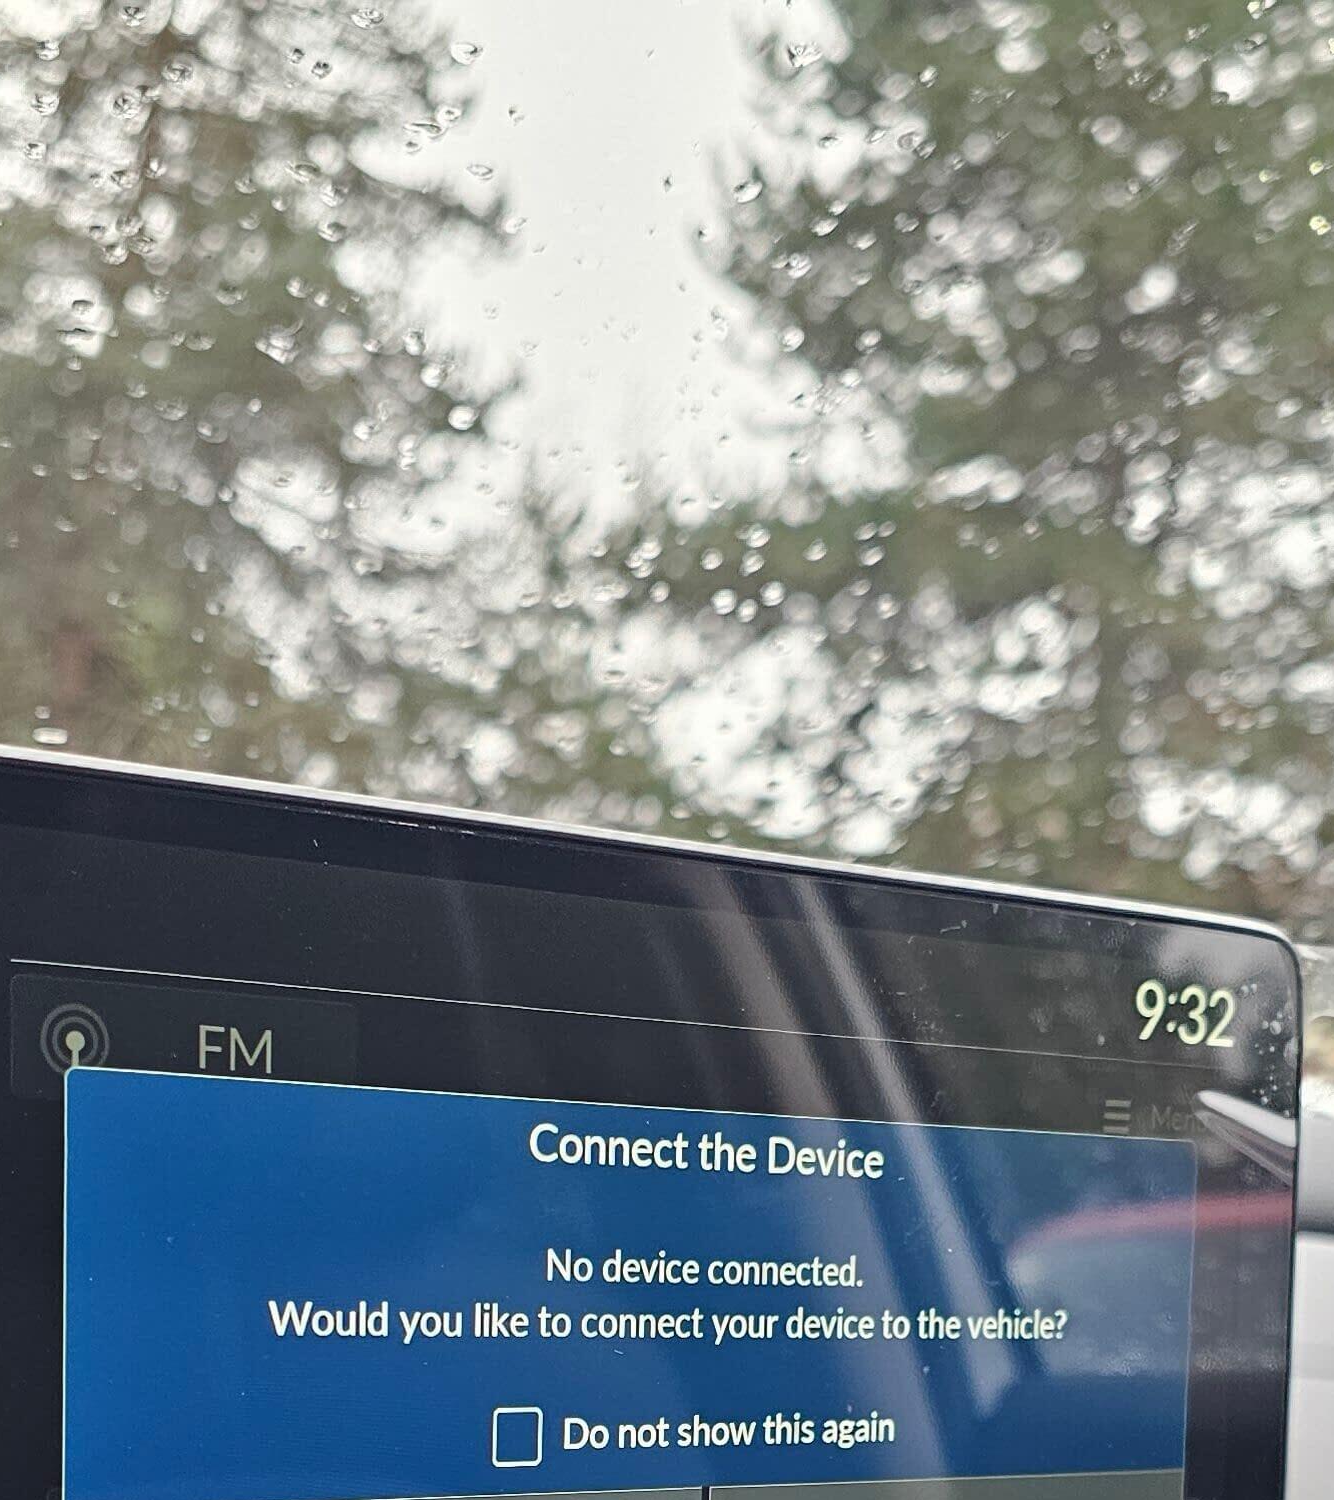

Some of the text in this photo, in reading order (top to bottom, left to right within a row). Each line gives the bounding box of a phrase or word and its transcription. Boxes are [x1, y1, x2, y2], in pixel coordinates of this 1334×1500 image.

[1134, 978, 1238, 1049] 9:32
[198, 1024, 273, 1075] FM
[529, 1122, 884, 1179] Connect the Device
[546, 1247, 865, 1288] No device connected.
[268, 1300, 1068, 1346] Would you like to connect your device to the vehicle?
[563, 1410, 895, 1451] Do not show this again
